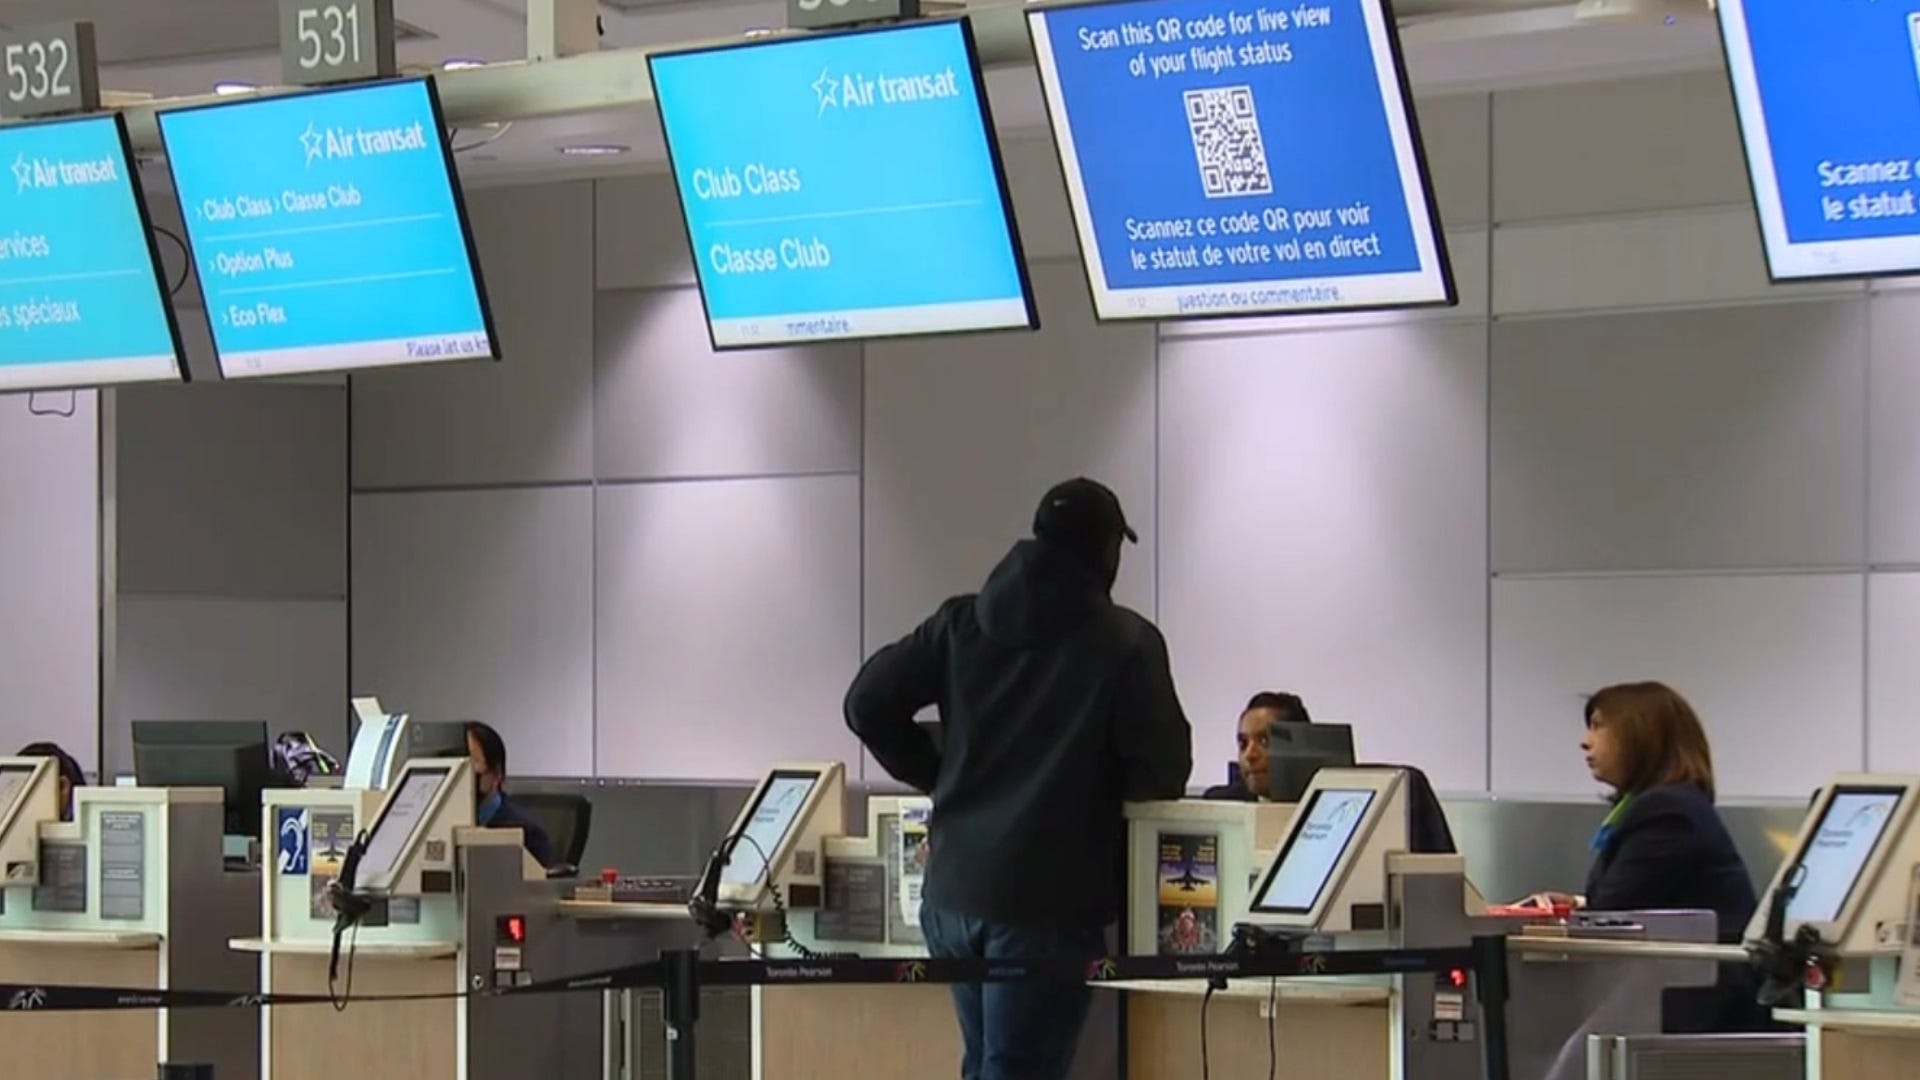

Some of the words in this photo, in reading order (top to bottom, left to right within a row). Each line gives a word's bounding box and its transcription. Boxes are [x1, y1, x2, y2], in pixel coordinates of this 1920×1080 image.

[299, 4, 359, 68] 531
[1078, 26, 1120, 50] Scan
[1122, 20, 1154, 46] this
[1157, 17, 1183, 42] QR
[1186, 13, 1226, 38] code
[1229, 10, 1253, 35] for
[1257, 7, 1289, 32] live
[1292, 4, 1331, 28] view
[6, 38, 71, 101] 532
[1129, 51, 1147, 77] of
[1149, 53, 1187, 78] your
[1191, 45, 1236, 75] flight
[1239, 41, 1294, 67] status
[843, 72, 874, 108] Air
[879, 64, 959, 104] transat
[326, 125, 355, 160] Air
[357, 120, 427, 156] transat
[34, 159, 58, 188] Air
[60, 155, 118, 186] transat
[693, 166, 743, 200] Club
[744, 162, 802, 196] Class
[1818, 160, 1912, 188] Scannez
[204, 197, 236, 222] Club
[236, 195, 273, 218] Class
[282, 190, 328, 213] Classe
[328, 185, 362, 208] Club
[1125, 217, 1194, 241] Scannez
[1197, 218, 1217, 236] ce
[1220, 211, 1260, 234] code
[1263, 208, 1291, 232] QR
[1293, 207, 1332, 233] pour
[1336, 200, 1371, 226] voir
[1821, 195, 1845, 221] le
[1848, 189, 1917, 220] statut
[216, 251, 265, 278] Option
[265, 248, 294, 271] Plus
[710, 242, 779, 276] Classe
[780, 236, 832, 269] Club
[1131, 247, 1148, 271] le
[1152, 246, 1200, 270] statut
[1203, 242, 1224, 266] de
[1224, 241, 1271, 265] votre
[1273, 237, 1300, 261] vol
[1303, 240, 1327, 259] en
[1329, 232, 1382, 259] direct
[12, 294, 82, 333] spéciaux
[229, 306, 257, 327] Eco
[259, 302, 287, 325] Flex
